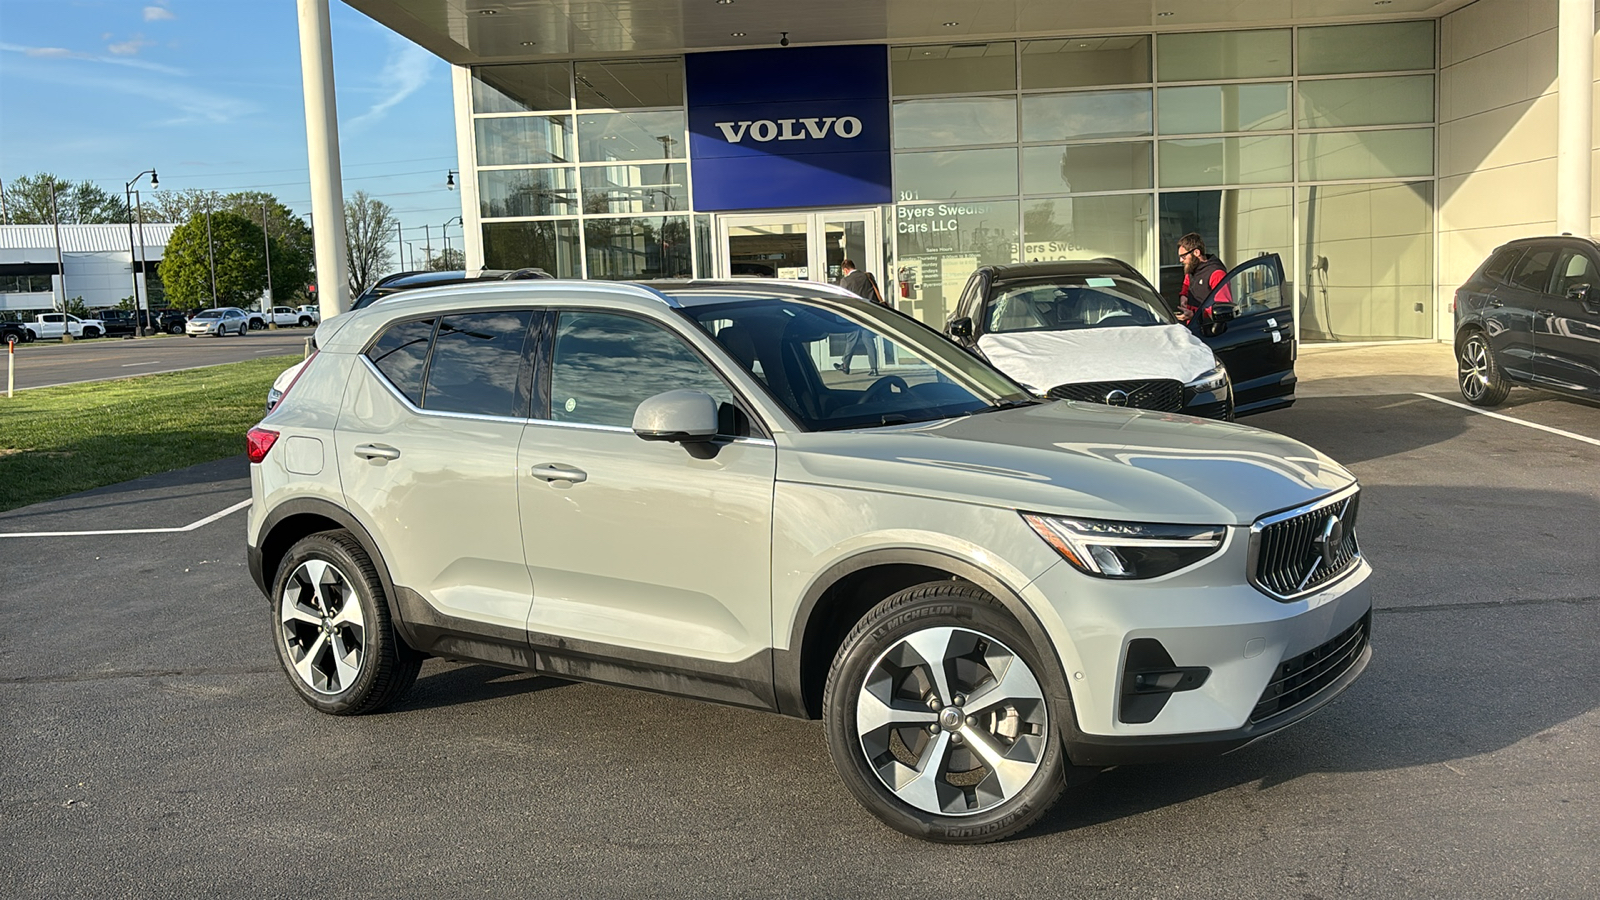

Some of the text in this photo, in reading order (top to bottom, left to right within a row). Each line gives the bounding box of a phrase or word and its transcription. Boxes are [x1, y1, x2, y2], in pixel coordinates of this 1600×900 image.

[714, 116, 863, 143] VOLVO
[898, 203, 993, 220] Byers Swedish
[898, 219, 958, 233] Cars LLC
[887, 606, 952, 631] MICHELIN
[948, 814, 1016, 838] MICHELIN
